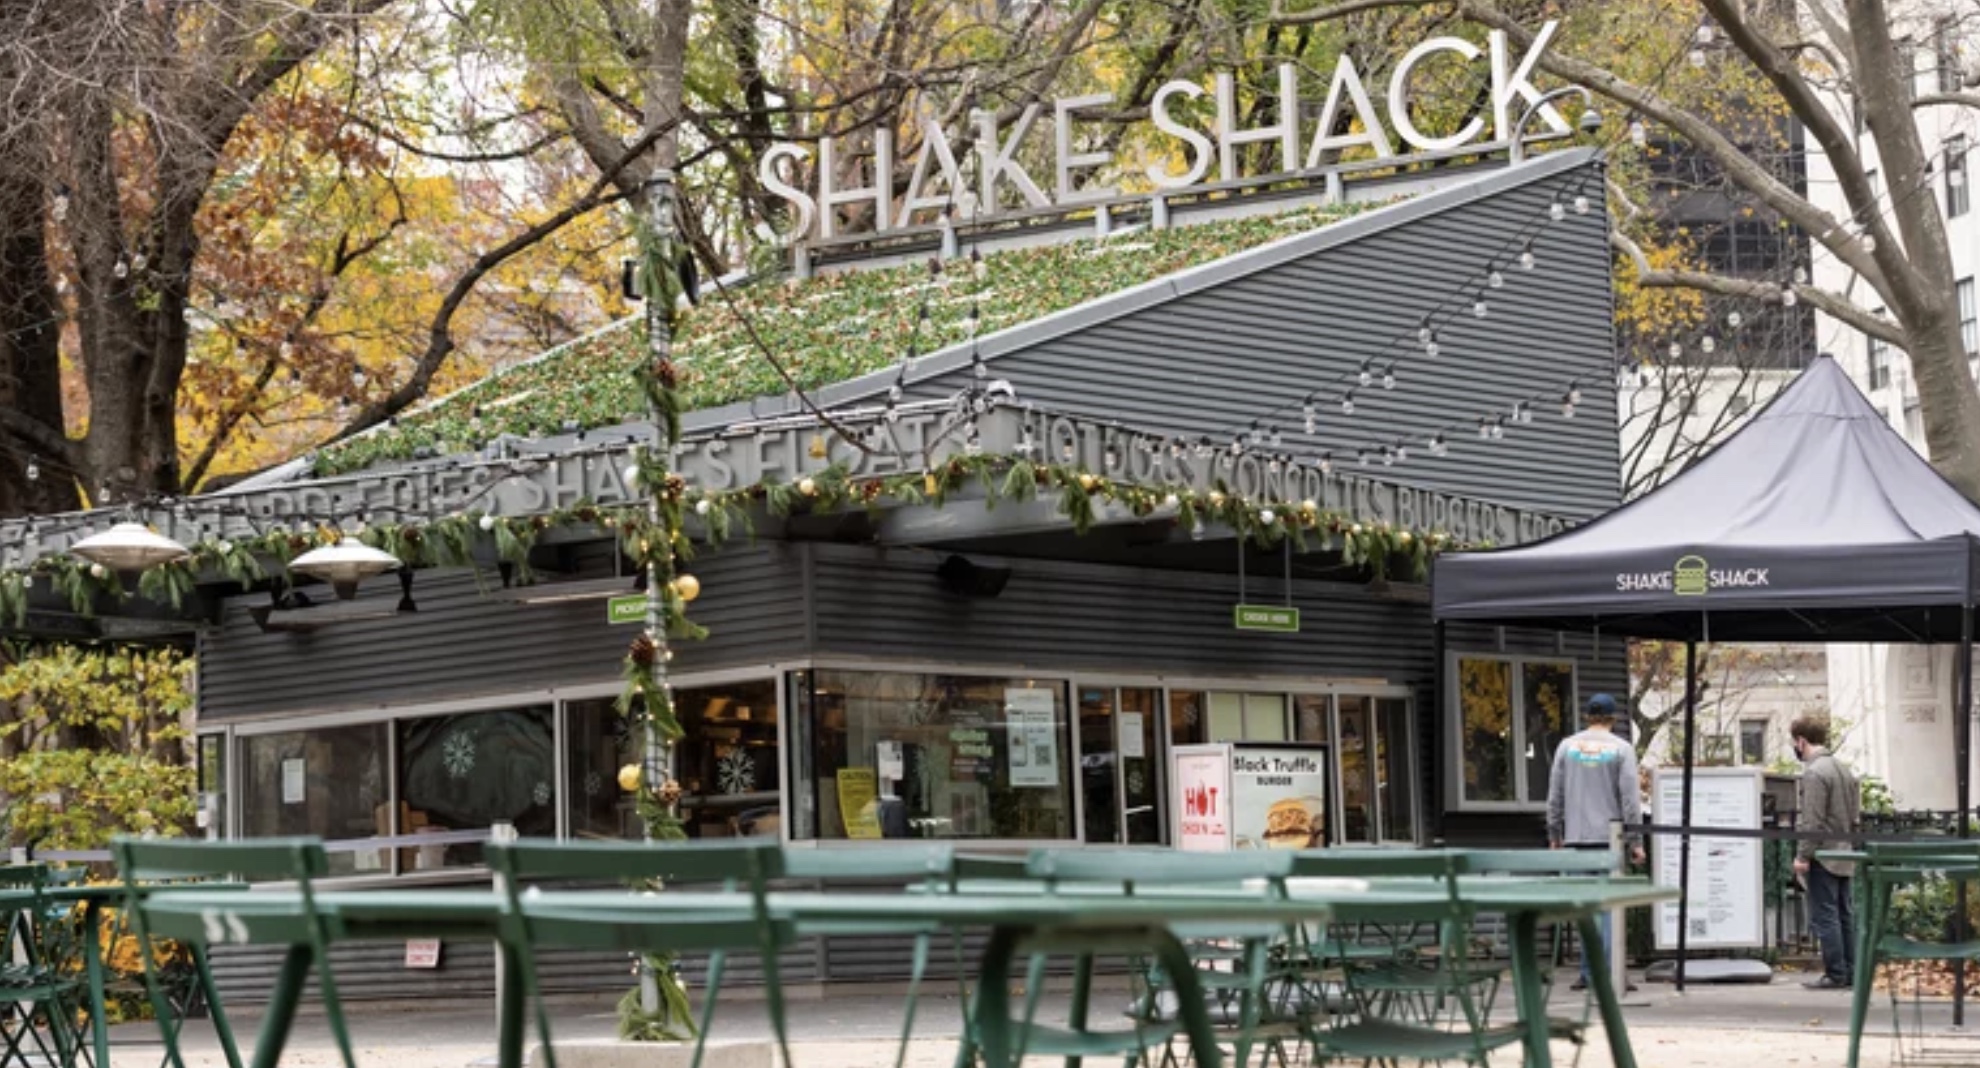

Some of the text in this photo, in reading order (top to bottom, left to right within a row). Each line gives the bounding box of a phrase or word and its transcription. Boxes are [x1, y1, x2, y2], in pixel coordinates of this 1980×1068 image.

[756, 20, 1572, 244] SHAKE SHACK
[510, 440, 736, 512] SHAES
[1400, 486, 1510, 546] BURGERS
[1616, 568, 1769, 591] SHAKE SHACK
[1233, 756, 1316, 773] Black Truffle
[1185, 786, 1218, 817] HOT
